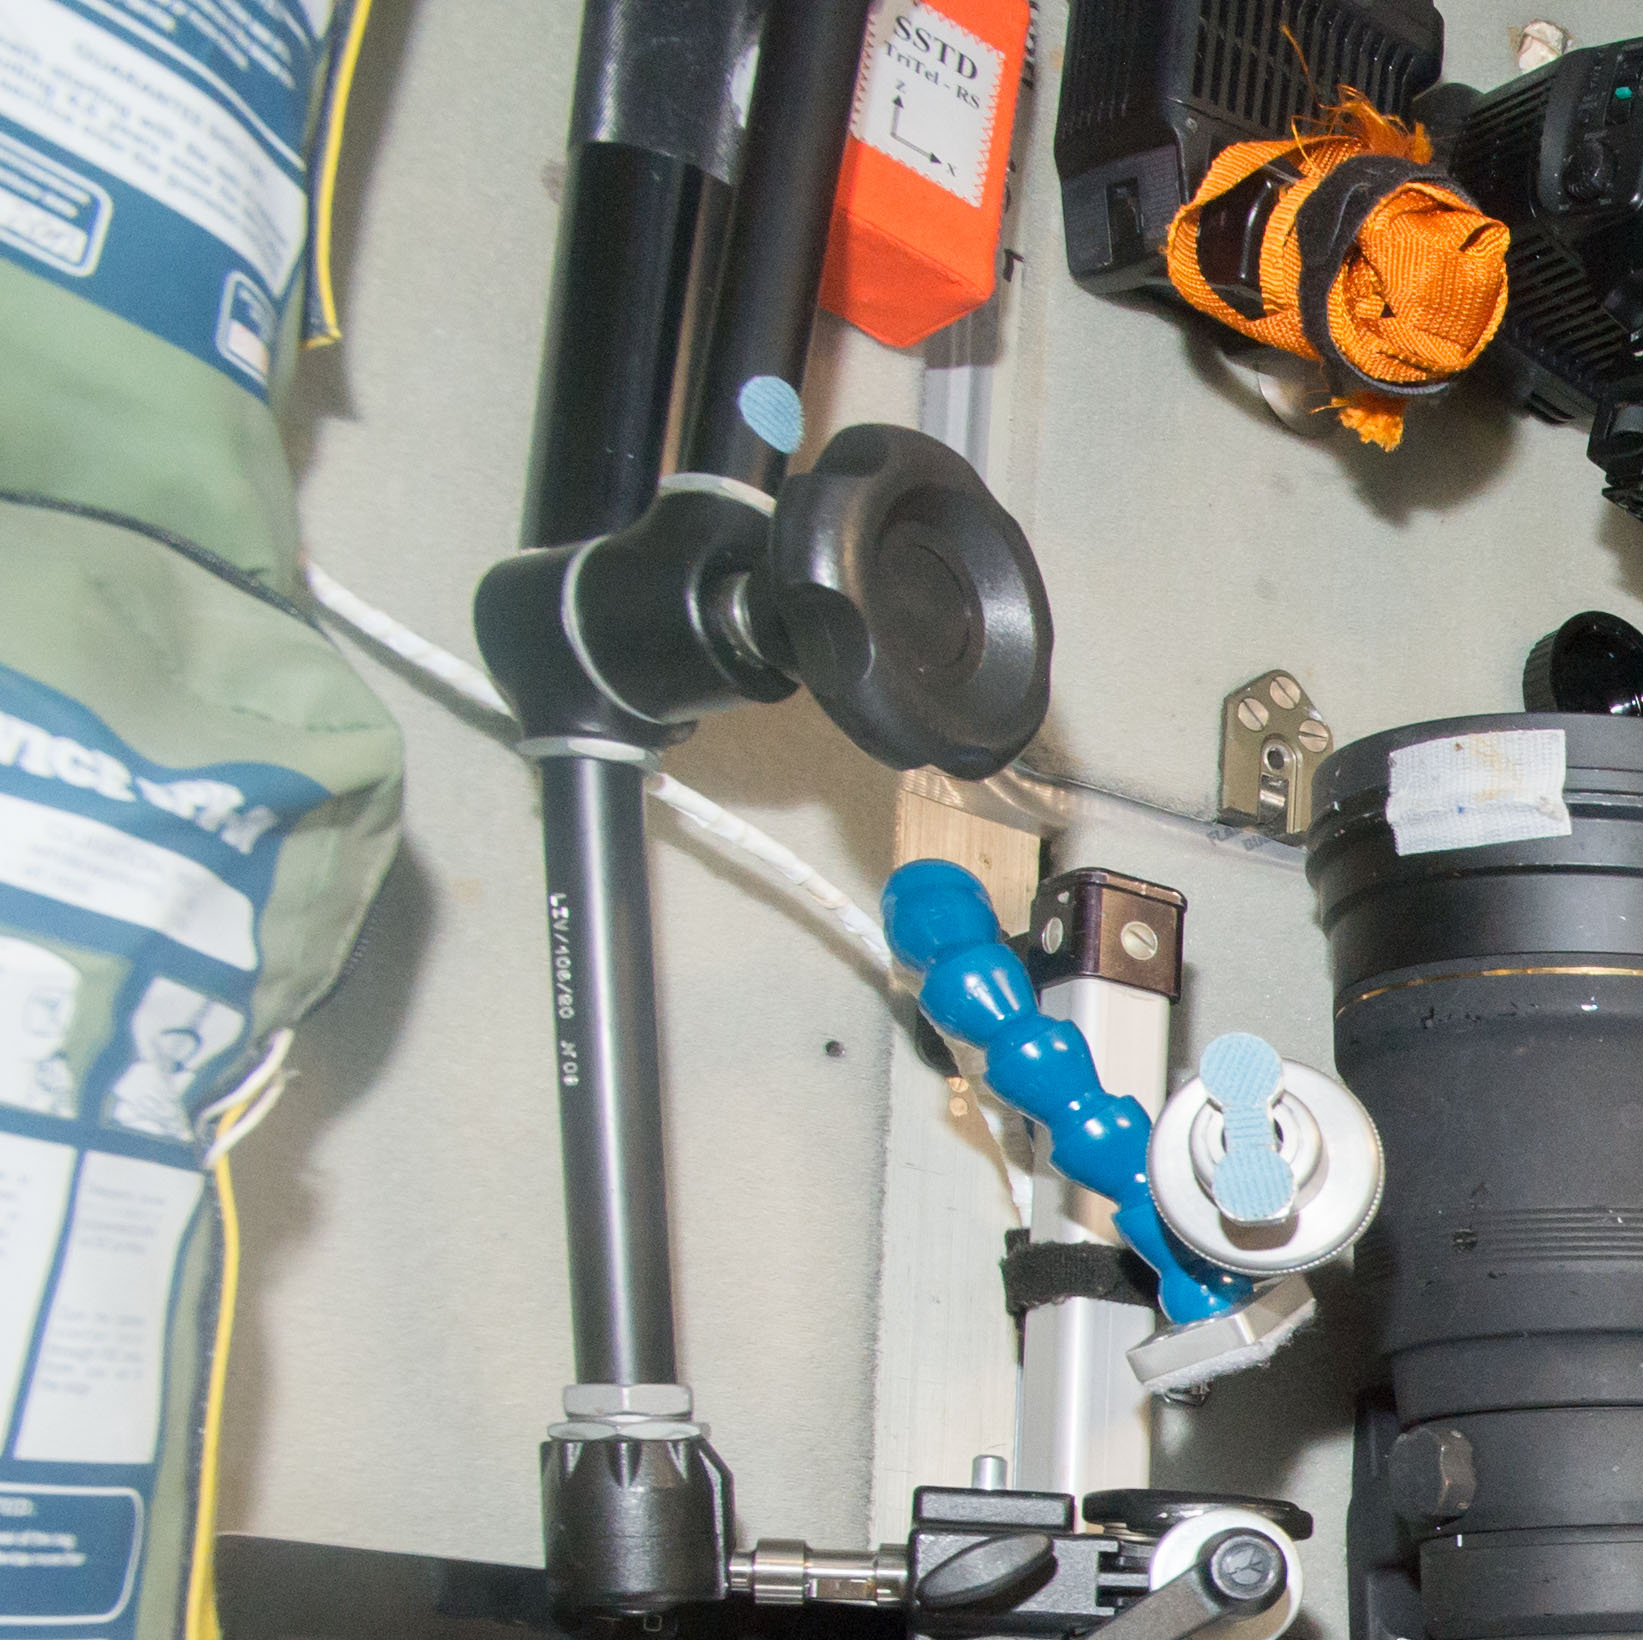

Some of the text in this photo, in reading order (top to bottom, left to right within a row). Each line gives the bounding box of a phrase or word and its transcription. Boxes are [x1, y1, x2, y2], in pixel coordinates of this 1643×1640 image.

[883, 40, 939, 86] TriTel
[956, 85, 980, 109] RS
[893, 15, 979, 80] SSTD
